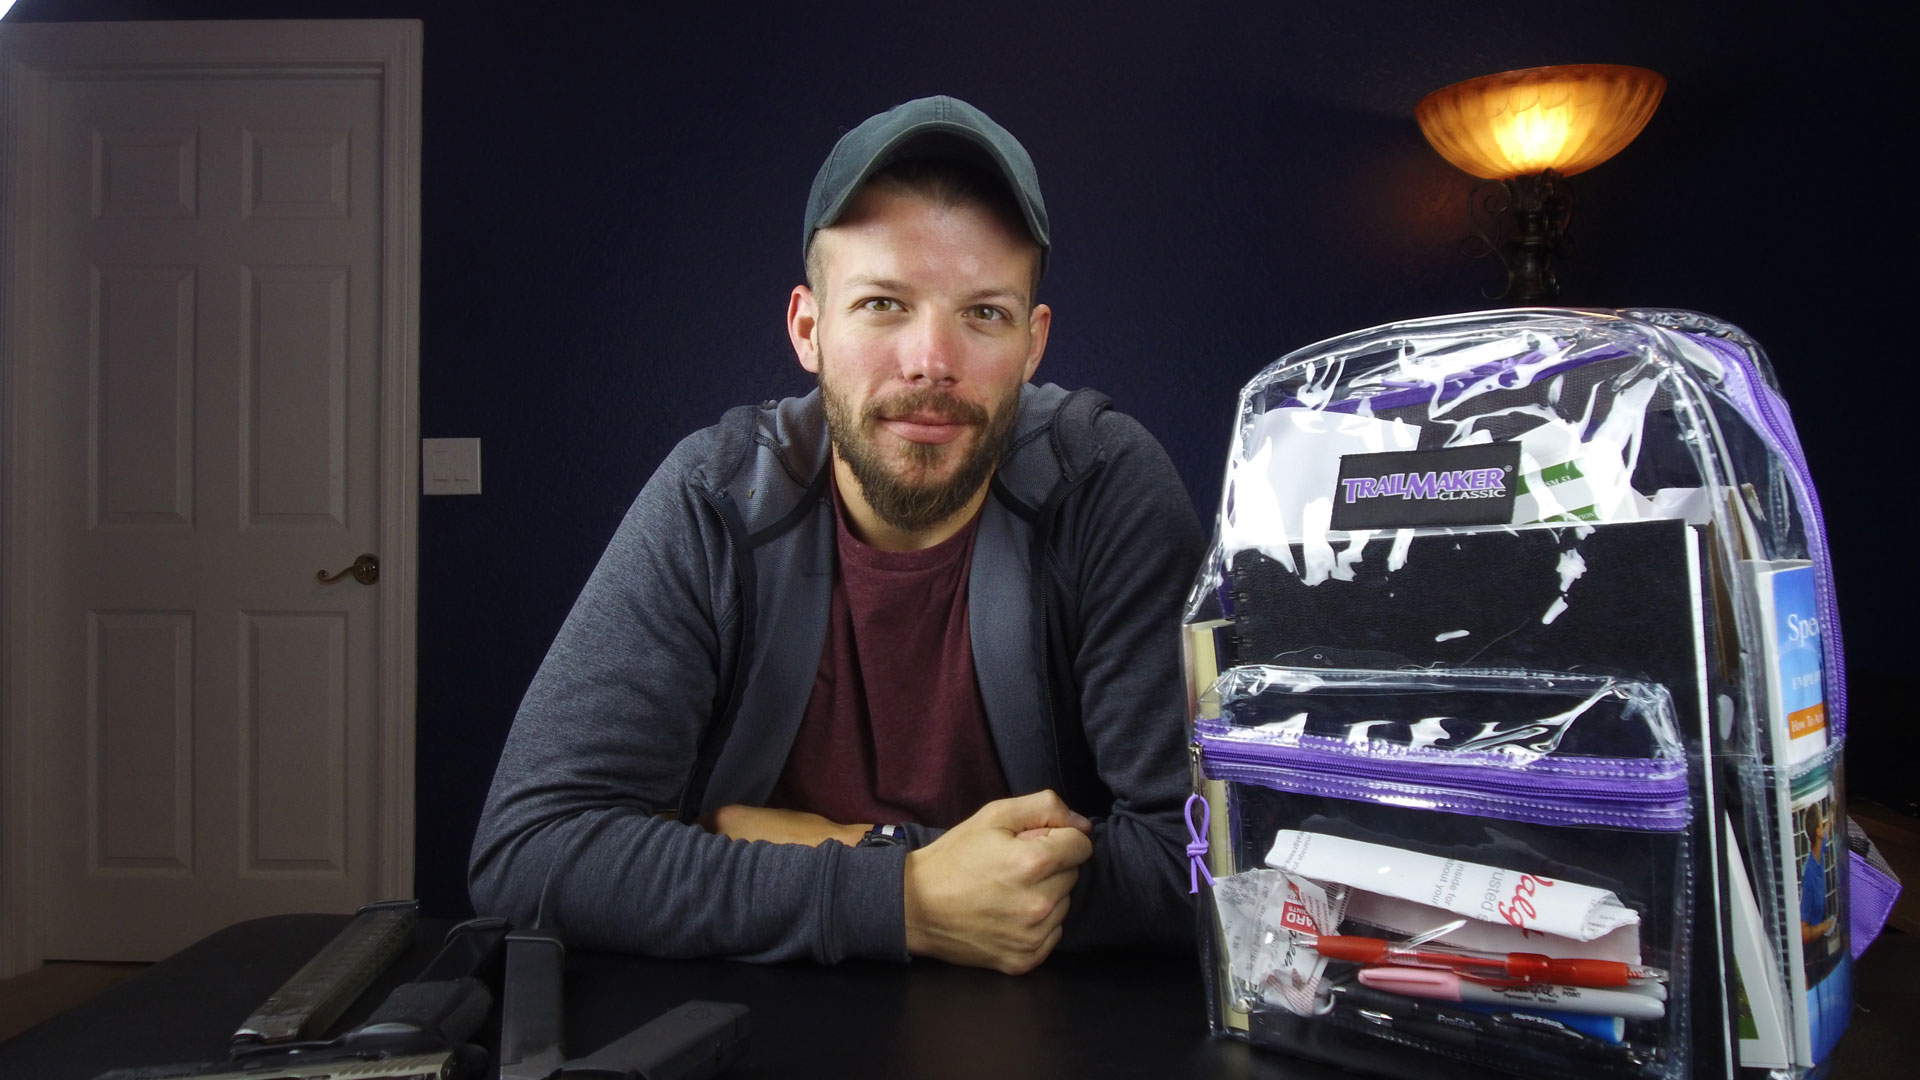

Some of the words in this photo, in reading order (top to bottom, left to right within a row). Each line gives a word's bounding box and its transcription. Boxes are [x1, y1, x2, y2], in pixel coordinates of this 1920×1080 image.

[1342, 467, 1506, 503] TRAILMAKER
[1439, 488, 1506, 501] CLASSIC
[1788, 613, 1820, 647] Spe
[1439, 859, 1455, 882] bout
[1449, 864, 1465, 890] inside
[1432, 884, 1443, 905] your
[1286, 911, 1317, 930] ARD
